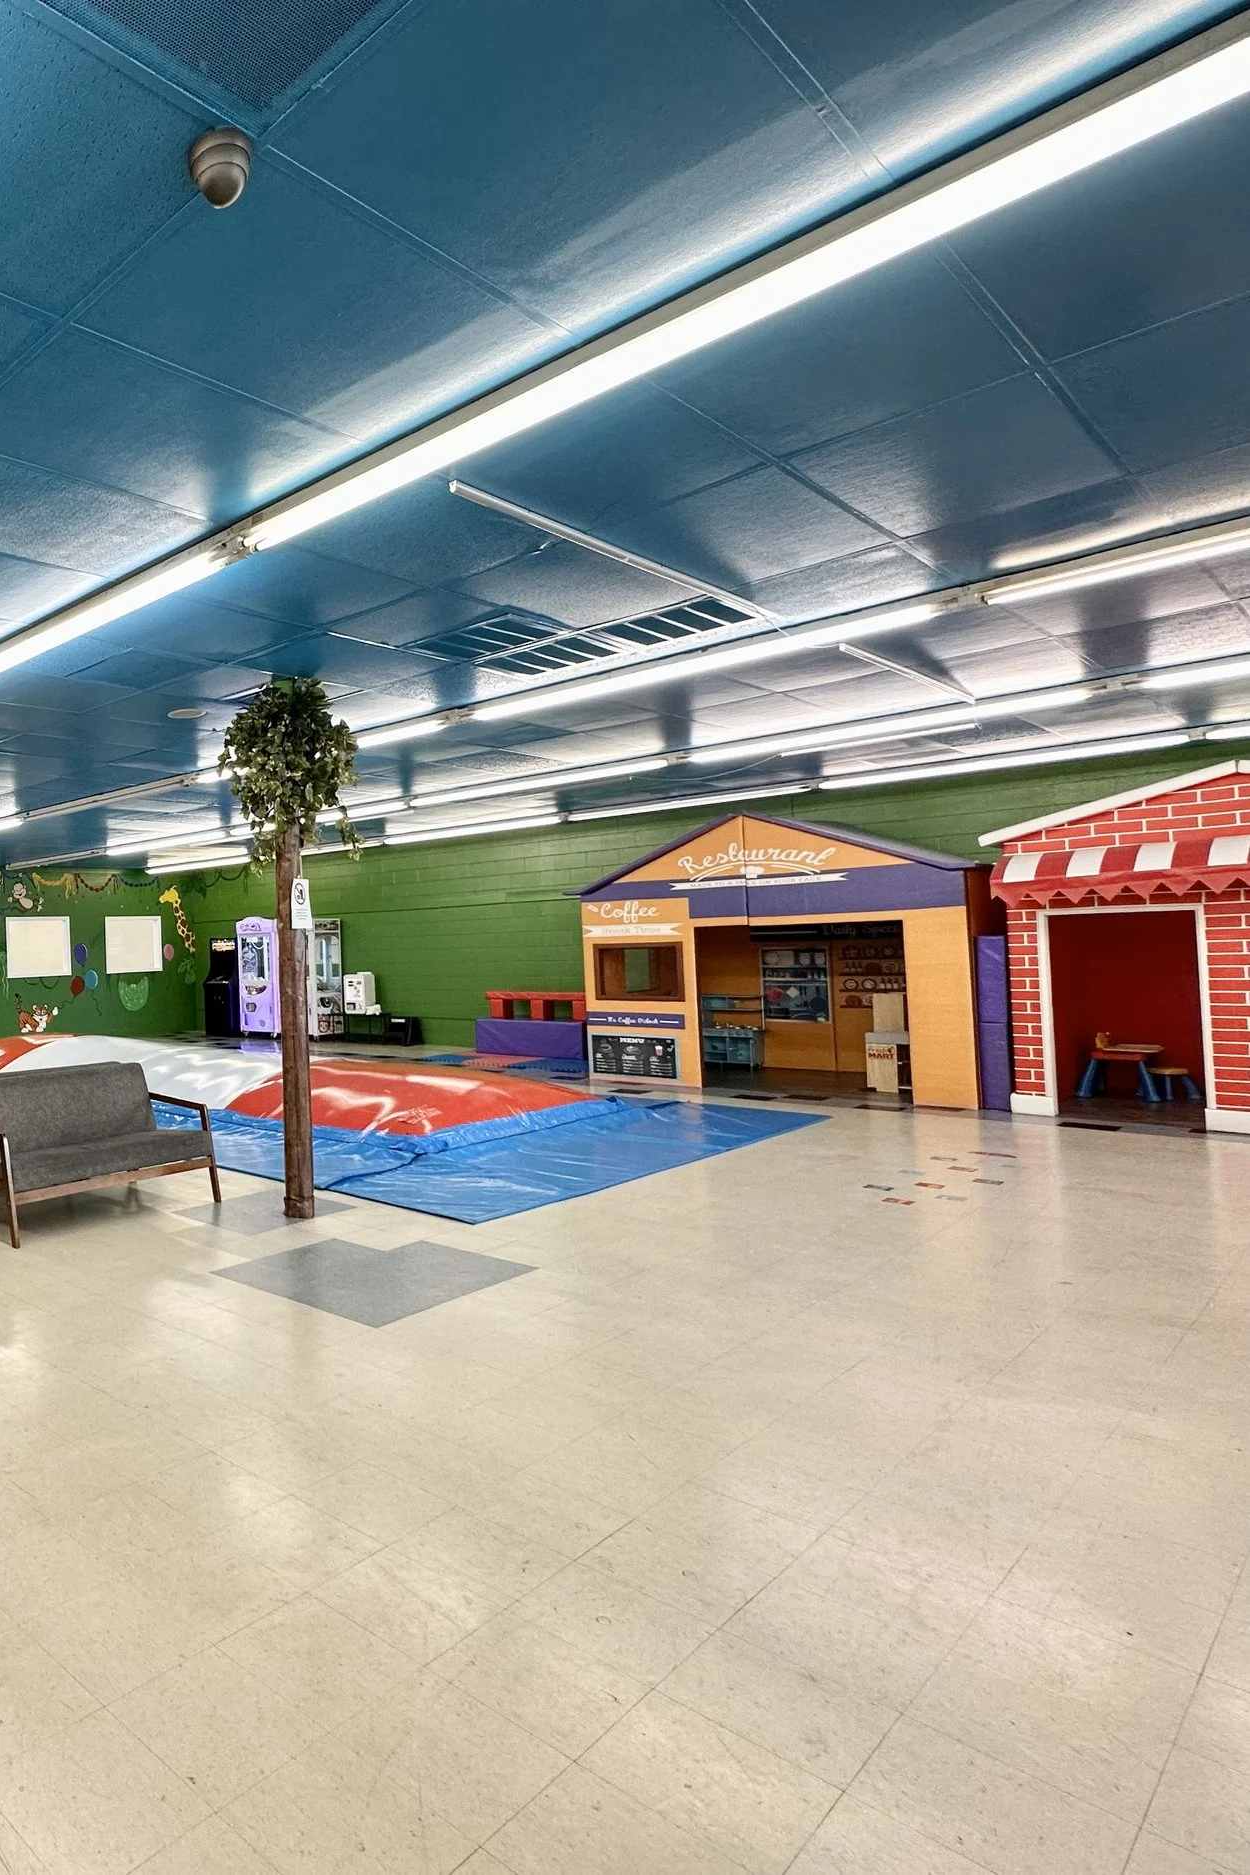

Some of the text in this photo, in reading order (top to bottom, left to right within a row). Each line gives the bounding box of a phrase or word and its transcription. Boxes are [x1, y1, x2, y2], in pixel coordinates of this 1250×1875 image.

[677, 842, 837, 874] Restaurant
[600, 901, 661, 923] Coffee
[868, 1052, 895, 1060] MART
